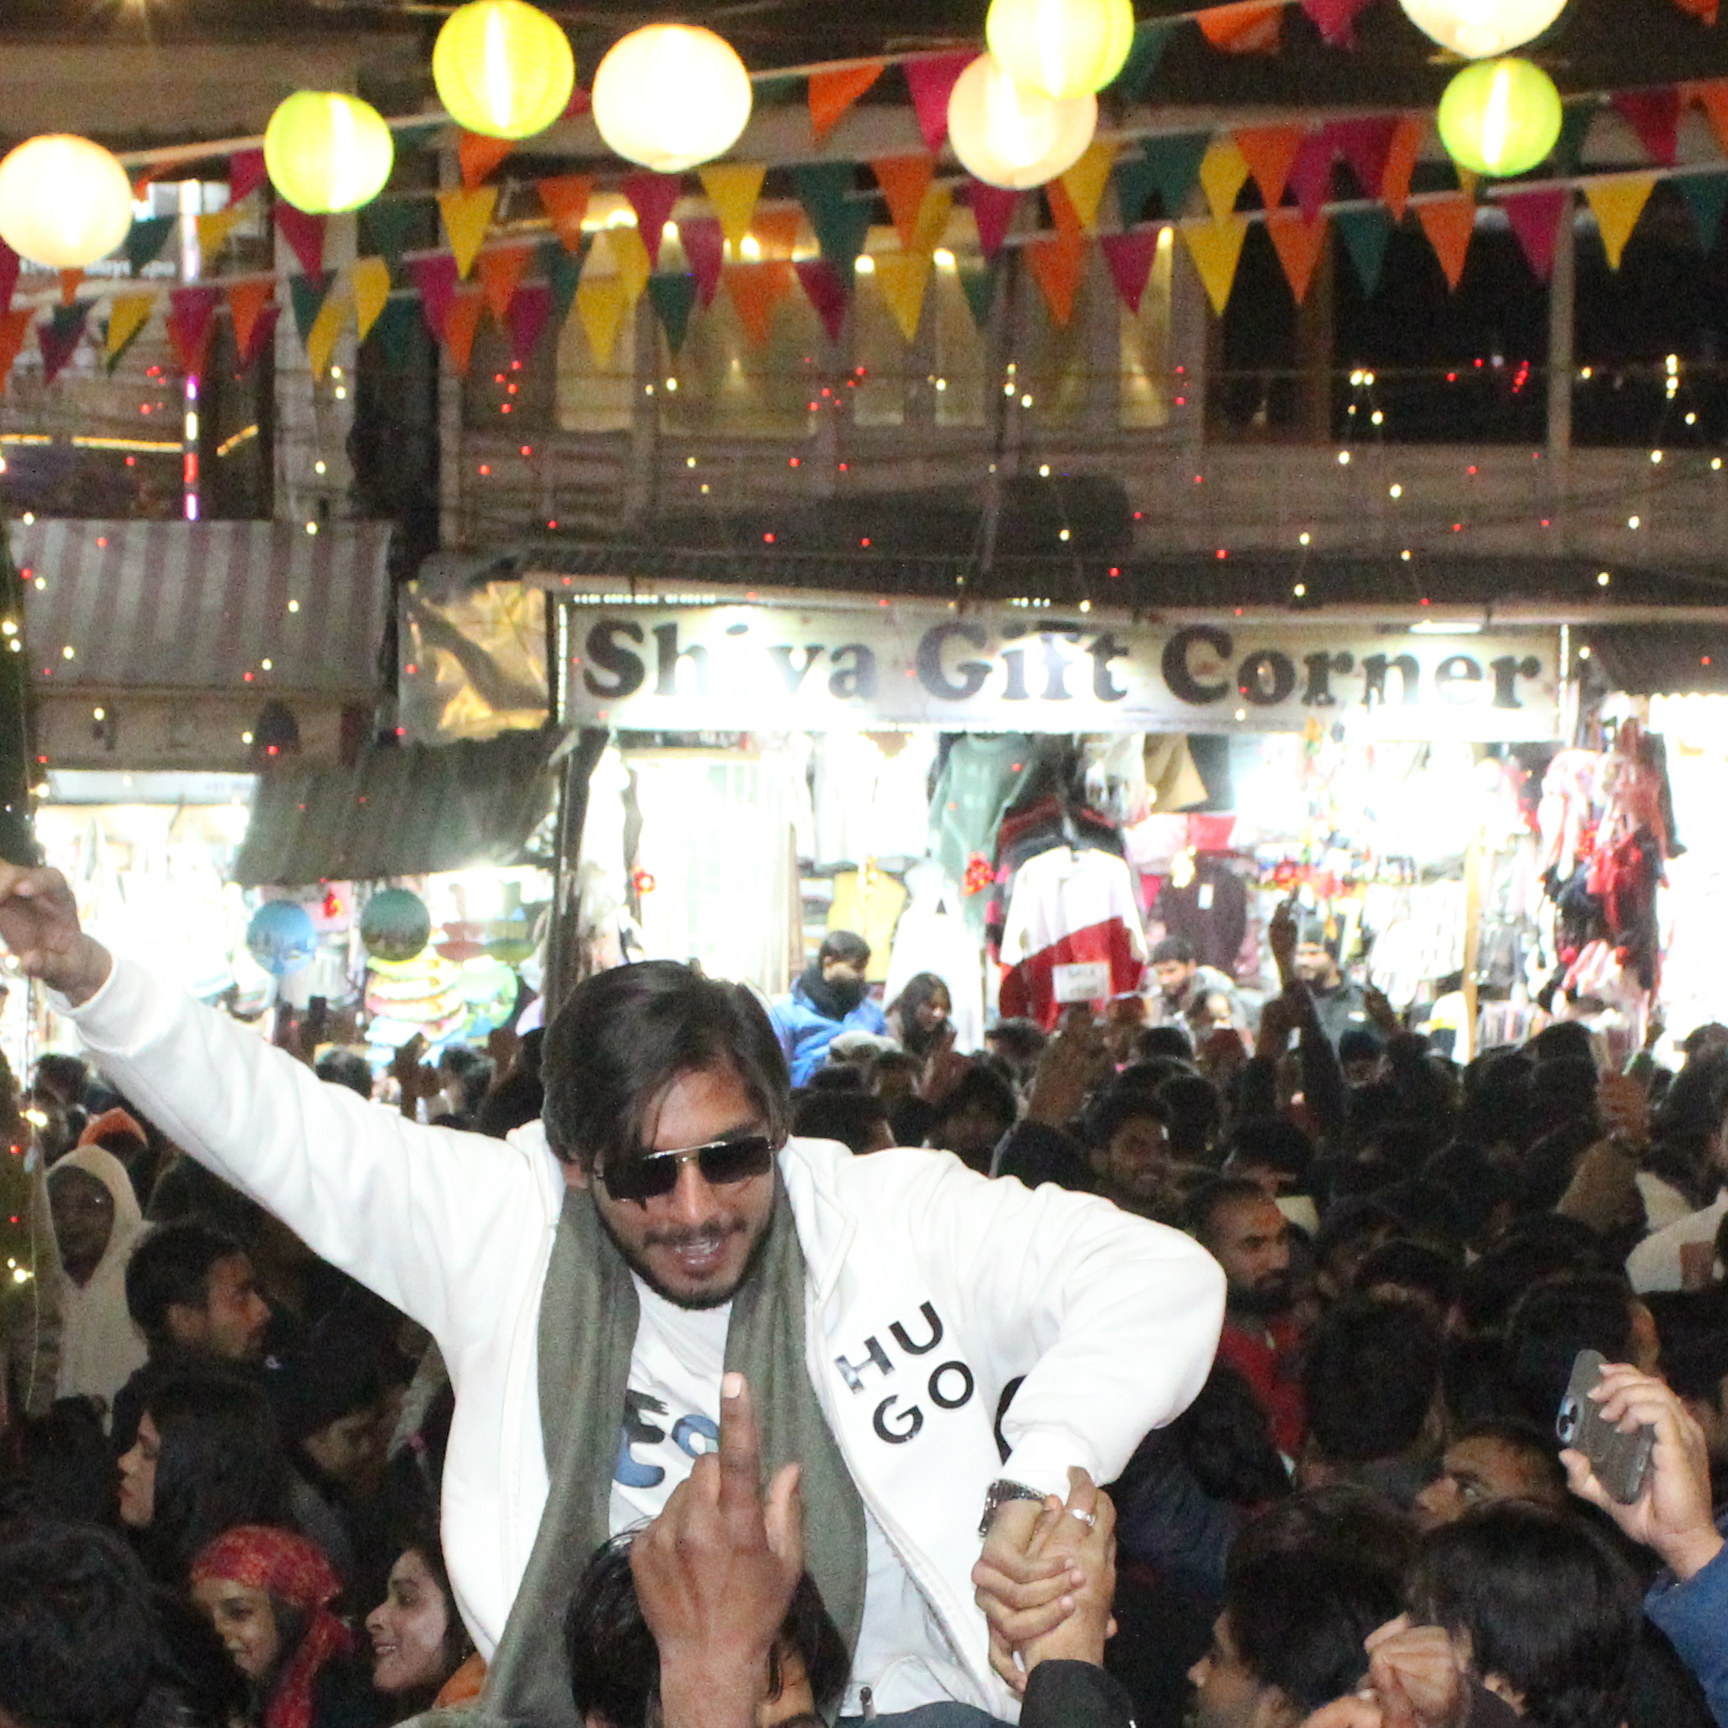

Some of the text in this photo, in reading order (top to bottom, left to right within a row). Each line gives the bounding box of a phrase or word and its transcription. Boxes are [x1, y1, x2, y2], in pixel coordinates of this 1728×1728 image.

[915, 620, 1132, 702] Gift
[1160, 624, 1540, 708] Corner
[834, 1300, 945, 1395] HU
[872, 1360, 975, 1445] GO
